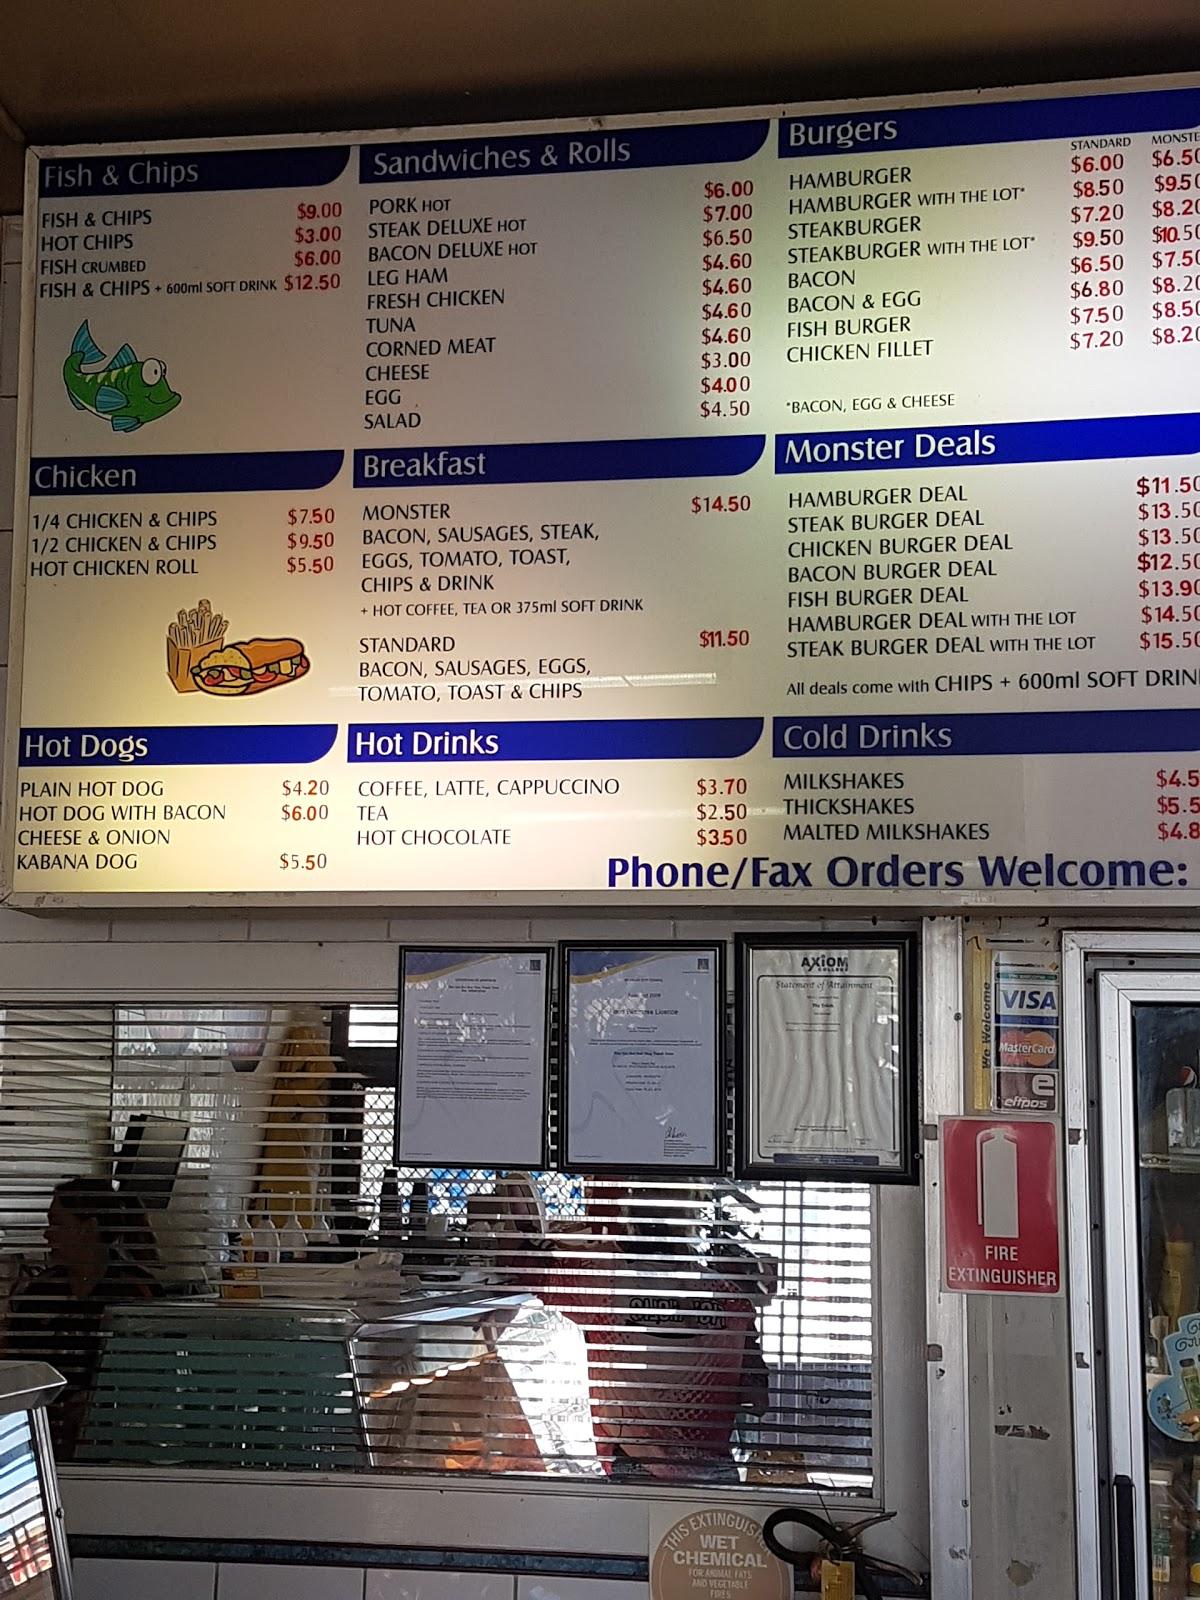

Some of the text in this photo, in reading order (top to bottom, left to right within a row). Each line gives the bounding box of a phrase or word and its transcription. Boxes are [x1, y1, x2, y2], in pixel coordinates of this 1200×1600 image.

[790, 120, 897, 147] Burgers
[1071, 137, 1131, 151] STANDARD
[374, 138, 630, 175] Sandwiches & Rolls
[45, 161, 198, 188] Fish & Chips
[704, 180, 754, 200] $6.00
[1073, 178, 1124, 199] $8.50
[297, 202, 342, 221] $9.00
[369, 196, 451, 215] PORK HOT
[789, 191, 912, 215] HAMBURGER
[917, 192, 955, 206] WITH
[960, 189, 988, 204] THE
[42, 209, 152, 229] FISH & CHIPS
[1071, 204, 1124, 224] $7.20
[788, 215, 921, 240] STEAKBURGER
[703, 228, 752, 248] $6.50
[294, 249, 341, 268] $6.00
[368, 240, 538, 262] BACON DELUXE HOT
[40, 256, 147, 275] FISH CRUMBED
[1071, 254, 1124, 275] $6.50
[40, 282, 76, 298] FISH
[82, 282, 94, 297] &
[100, 279, 150, 297] CHIPS
[166, 281, 203, 294] 600ml
[206, 280, 236, 293] SOFT
[239, 279, 277, 293] DRINK
[284, 273, 340, 292] $12.50
[702, 277, 751, 297] $4.60
[788, 269, 855, 289] BACON
[368, 288, 505, 310] FRESH CHICKEN
[1071, 279, 1124, 300] $6.80
[788, 290, 921, 313] BACON & EGG
[702, 302, 751, 321] $4.60
[365, 316, 416, 334] TUNA
[1070, 330, 1123, 350] $7.20
[787, 339, 934, 363] CHICKEN FILLET
[700, 400, 750, 419] $4.50
[852, 397, 882, 411] EGG
[887, 397, 896, 409] &
[902, 394, 955, 408] CHEESE
[364, 412, 421, 430] SALAD
[785, 429, 995, 463] Monster Deals
[364, 451, 486, 478] Breakfast
[35, 464, 136, 488] Chicken
[691, 495, 751, 514] $14.50
[789, 485, 968, 508] HAMBURGER DEAL
[33, 510, 217, 532] 1/4 CHICKEN & CHIPS
[288, 508, 335, 526] $7.50
[362, 503, 450, 521] MONSTER
[363, 522, 599, 546] BACON, SAUSAGES, STEAK,
[30, 558, 199, 577] HOT CHICKEN ROLL
[287, 556, 334, 574] $5.50
[361, 574, 494, 593] CHIPS & DRINK
[373, 604, 403, 617] HOT
[406, 603, 458, 617] COFFEE,
[463, 602, 487, 615] TEA
[491, 602, 511, 614] OR
[516, 600, 557, 614] 375ml
[561, 599, 596, 613] SOFT
[600, 598, 643, 612] DRINK
[788, 611, 1077, 633] HAMBURGER DEAL WITH THE LOT
[359, 636, 455, 654] STANDARD
[699, 630, 750, 648] $11.50
[358, 682, 582, 702] TOMATO, TOAST & CHIPS
[356, 729, 499, 755] Hot Drinks
[784, 722, 952, 750] Cold Drinks
[26, 734, 148, 761] Hot Dogs
[21, 780, 163, 797] PLAIN HOT DOG
[282, 780, 329, 796] $4.20
[358, 778, 620, 798] COFFEE, LATTE, CAPPUCCINO
[697, 778, 747, 797] $3.70
[784, 772, 904, 790] MILKSHAKES
[19, 804, 225, 822] HOT DOG WITH BACON
[281, 804, 328, 821] $6.00
[357, 829, 510, 846] HOT CHOCOLATE
[697, 828, 747, 847] $3.50
[783, 823, 990, 840] MALTED MILKSHAKES
[608, 853, 1187, 889] Phone/Fax Orders Welcome:
[1003, 990, 1056, 1010] VISA
[981, 982, 992, 1044] Welcome
[999, 1042, 1055, 1054] MasterCard
[985, 1246, 1018, 1262] FIRE
[949, 1268, 1057, 1287] EXTINGUISHER
[663, 1523, 690, 1552] THIS
[699, 1534, 740, 1550] WET
[673, 1550, 768, 1569] CHEMICAL
